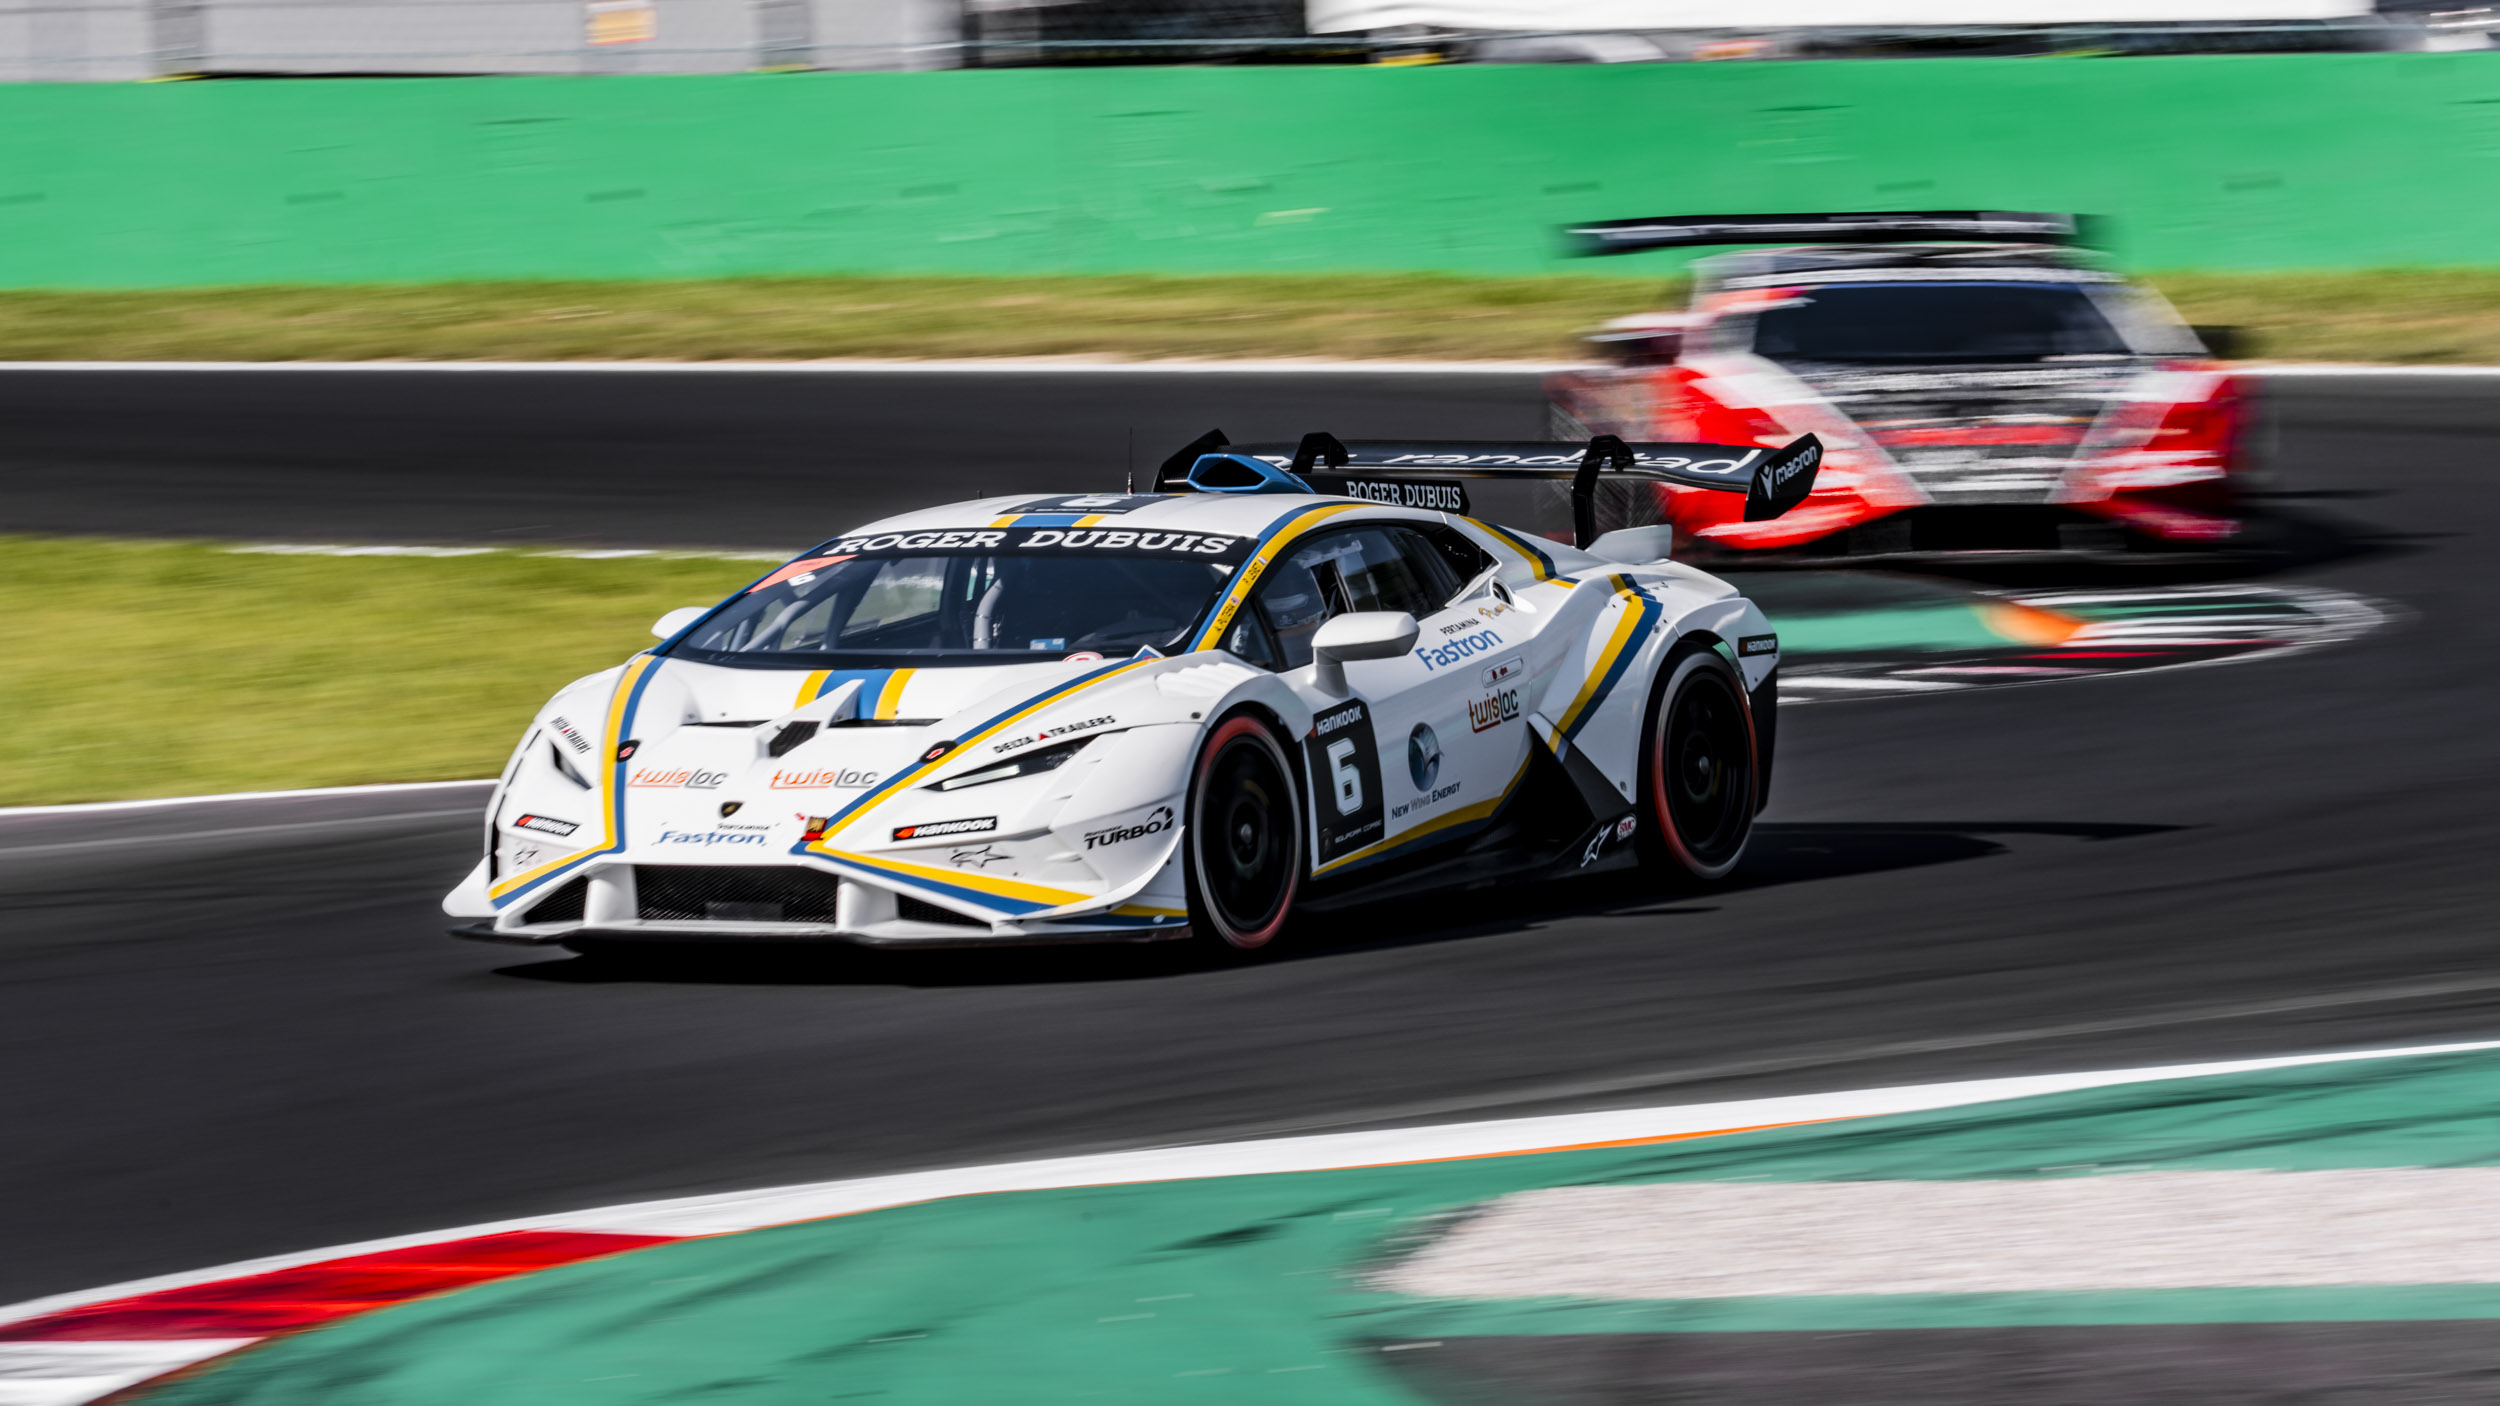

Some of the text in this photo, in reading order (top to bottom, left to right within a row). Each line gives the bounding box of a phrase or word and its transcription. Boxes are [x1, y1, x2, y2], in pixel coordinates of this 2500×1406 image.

[1775, 445, 1818, 486] macron
[1346, 481, 1461, 510] ROGER DUBUIS
[823, 530, 1236, 556] ROGER DUBUIS
[1440, 617, 1481, 636] PERTAMINA
[1415, 629, 1504, 672] Fastron
[1468, 688, 1520, 734] twisloc
[993, 715, 1117, 754] DELTA TRAILERS
[627, 767, 730, 790] twisloc
[769, 767, 879, 790] twisloc
[1326, 737, 1364, 817] 6
[1391, 780, 1462, 820] NEW WING ENERGY
[657, 830, 767, 845] Fastron
[1084, 820, 1162, 850] TURBO
